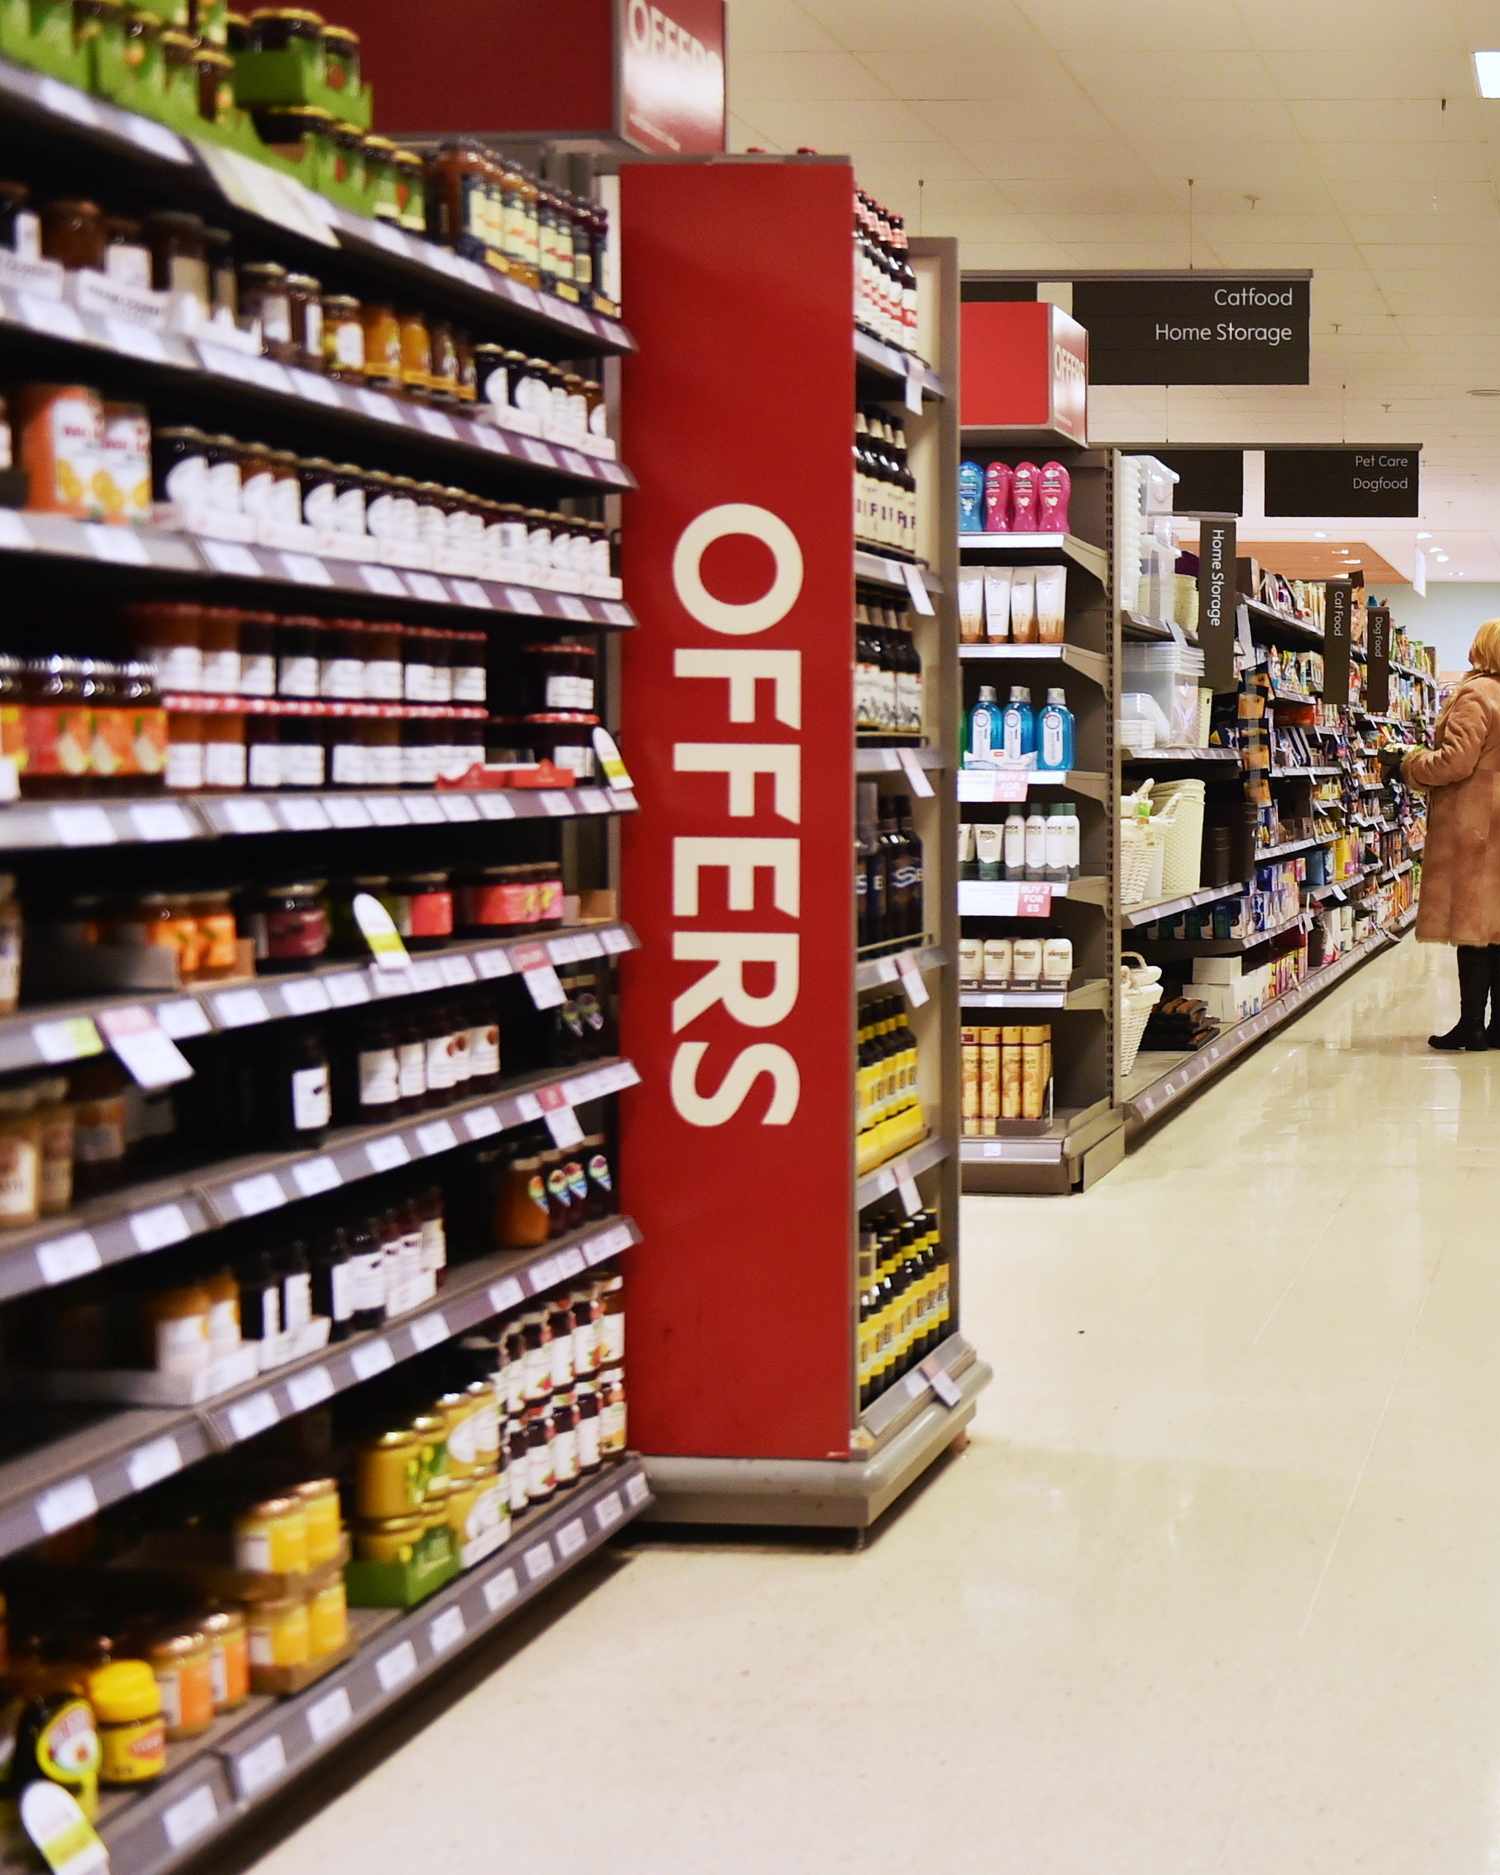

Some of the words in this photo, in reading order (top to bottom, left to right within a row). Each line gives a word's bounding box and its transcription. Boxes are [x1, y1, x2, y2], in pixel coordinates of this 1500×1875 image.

[1214, 287, 1294, 307] Catfood
[1155, 323, 1212, 341] Home
[1217, 323, 1293, 345] Storage
[1355, 455, 1375, 468] Pet
[1378, 455, 1409, 468] Care
[1353, 476, 1408, 493] Dogfood
[1211, 529, 1225, 570] Home
[1207, 572, 1225, 627] Storage
[1334, 591, 1345, 609] Cat
[1333, 611, 1344, 637] Food
[1373, 616, 1383, 634] Dog
[670, 503, 804, 1127] OFFERS
[1023, 894, 1044, 904] FOR
